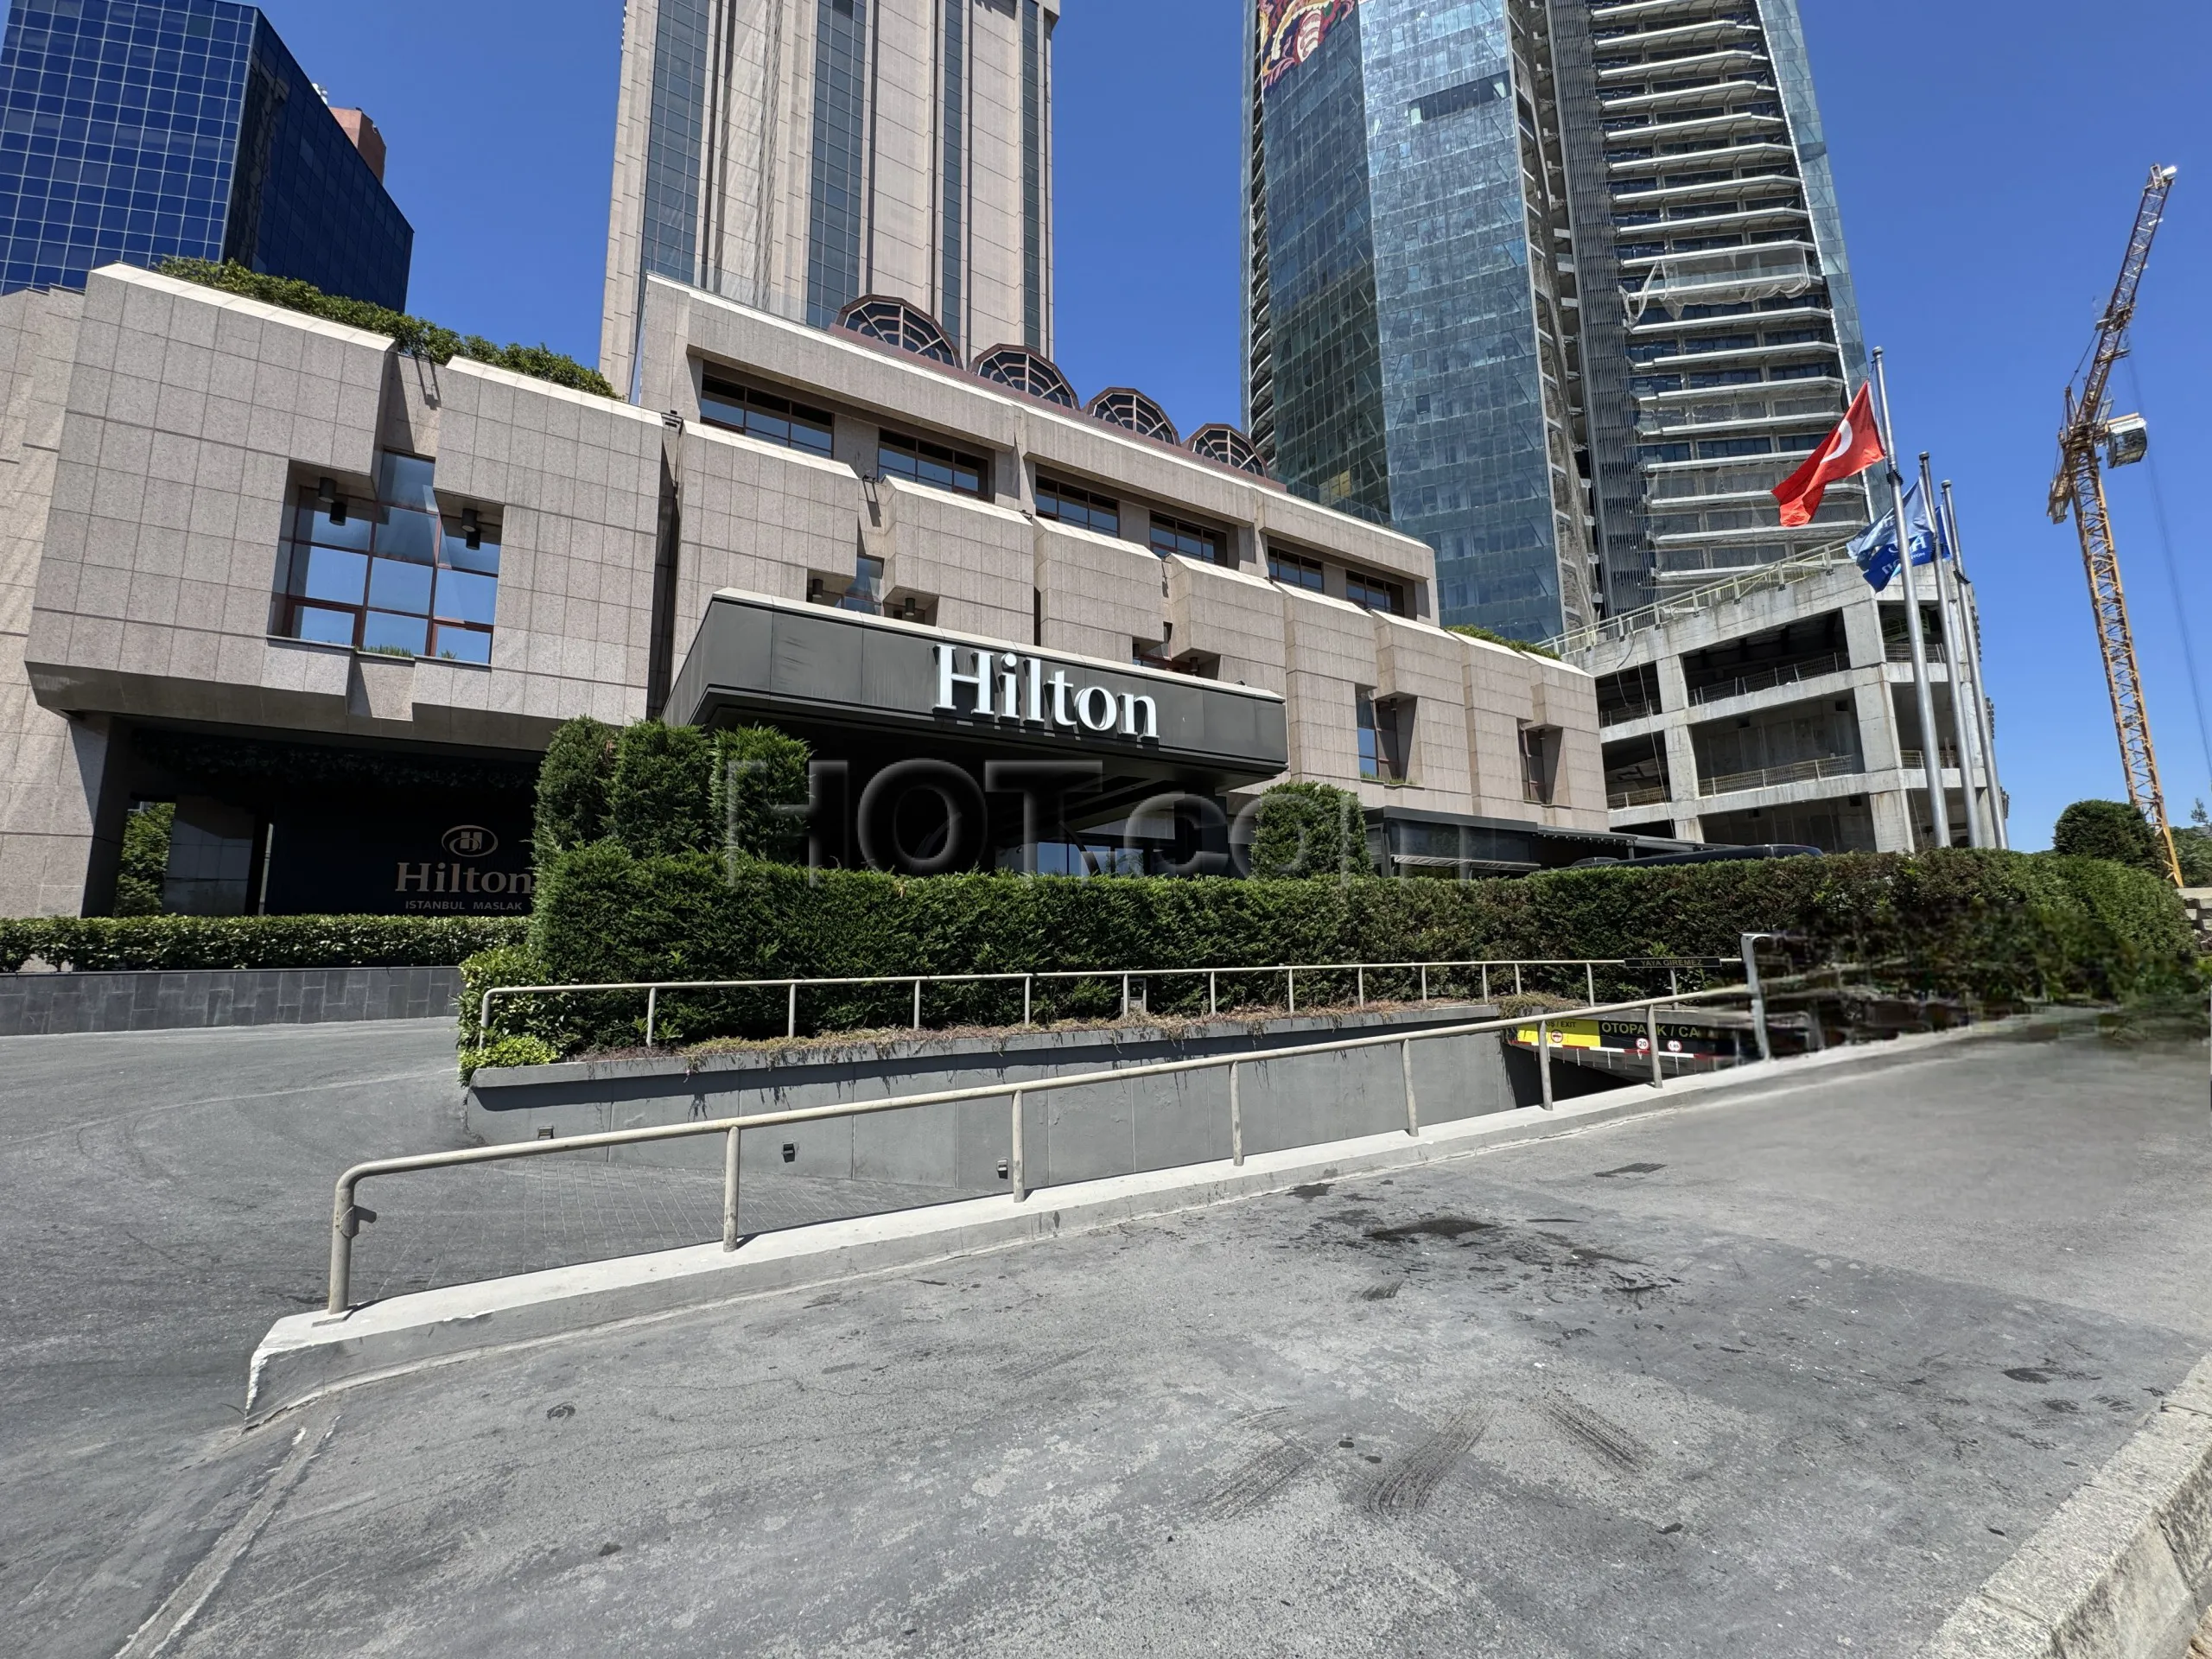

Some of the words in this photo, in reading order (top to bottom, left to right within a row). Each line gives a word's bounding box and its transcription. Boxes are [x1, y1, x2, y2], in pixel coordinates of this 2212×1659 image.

[933, 644, 1160, 740] Hilton
[395, 861, 534, 895] Hilton
[405, 900, 466, 911] ISTANBUL
[473, 901, 523, 912] MASLAK
[1601, 1021, 1668, 1037] OTOPAK
